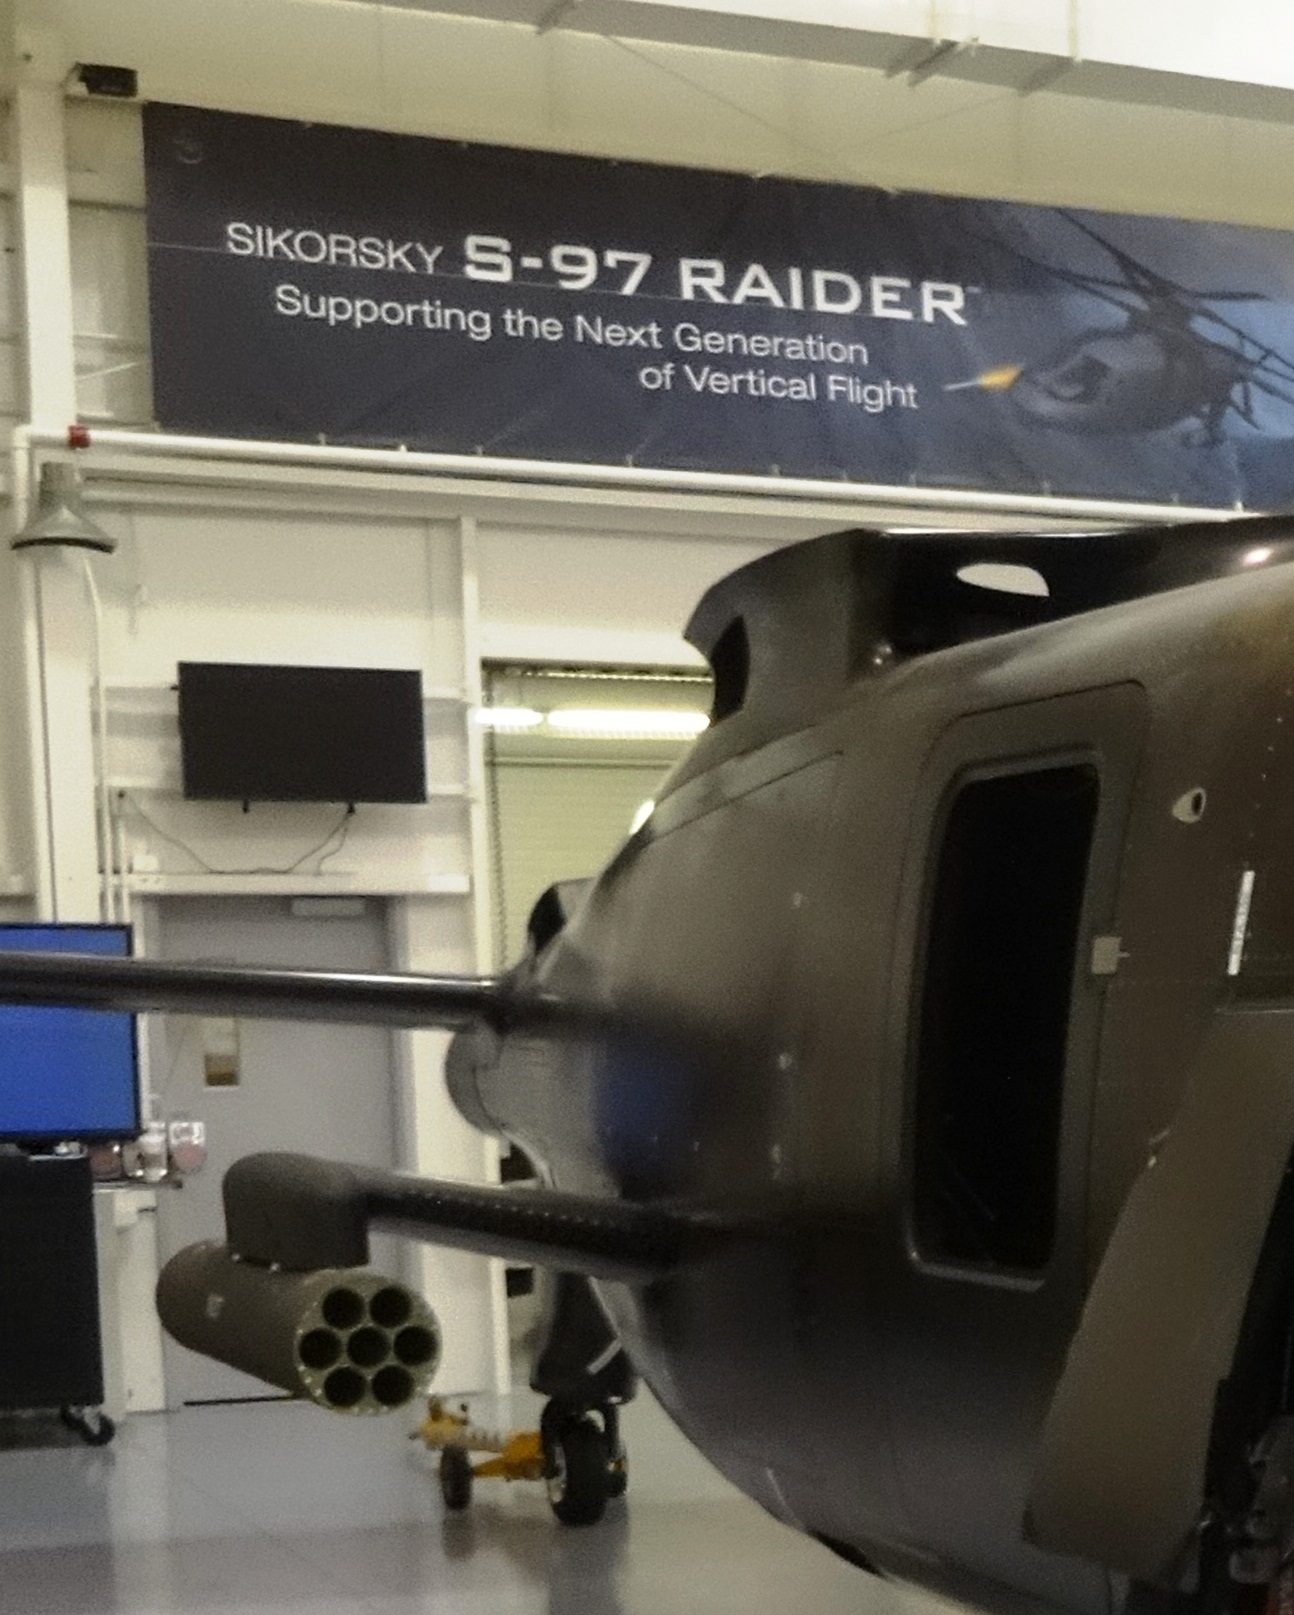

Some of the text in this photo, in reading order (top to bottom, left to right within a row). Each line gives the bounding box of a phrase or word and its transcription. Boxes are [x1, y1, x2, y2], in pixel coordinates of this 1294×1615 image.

[226, 221, 967, 326] SIKORSKY S-97 RAIDER
[275, 284, 868, 365] Supporting the Next Generation
[639, 362, 918, 414] of Vertical Flight
